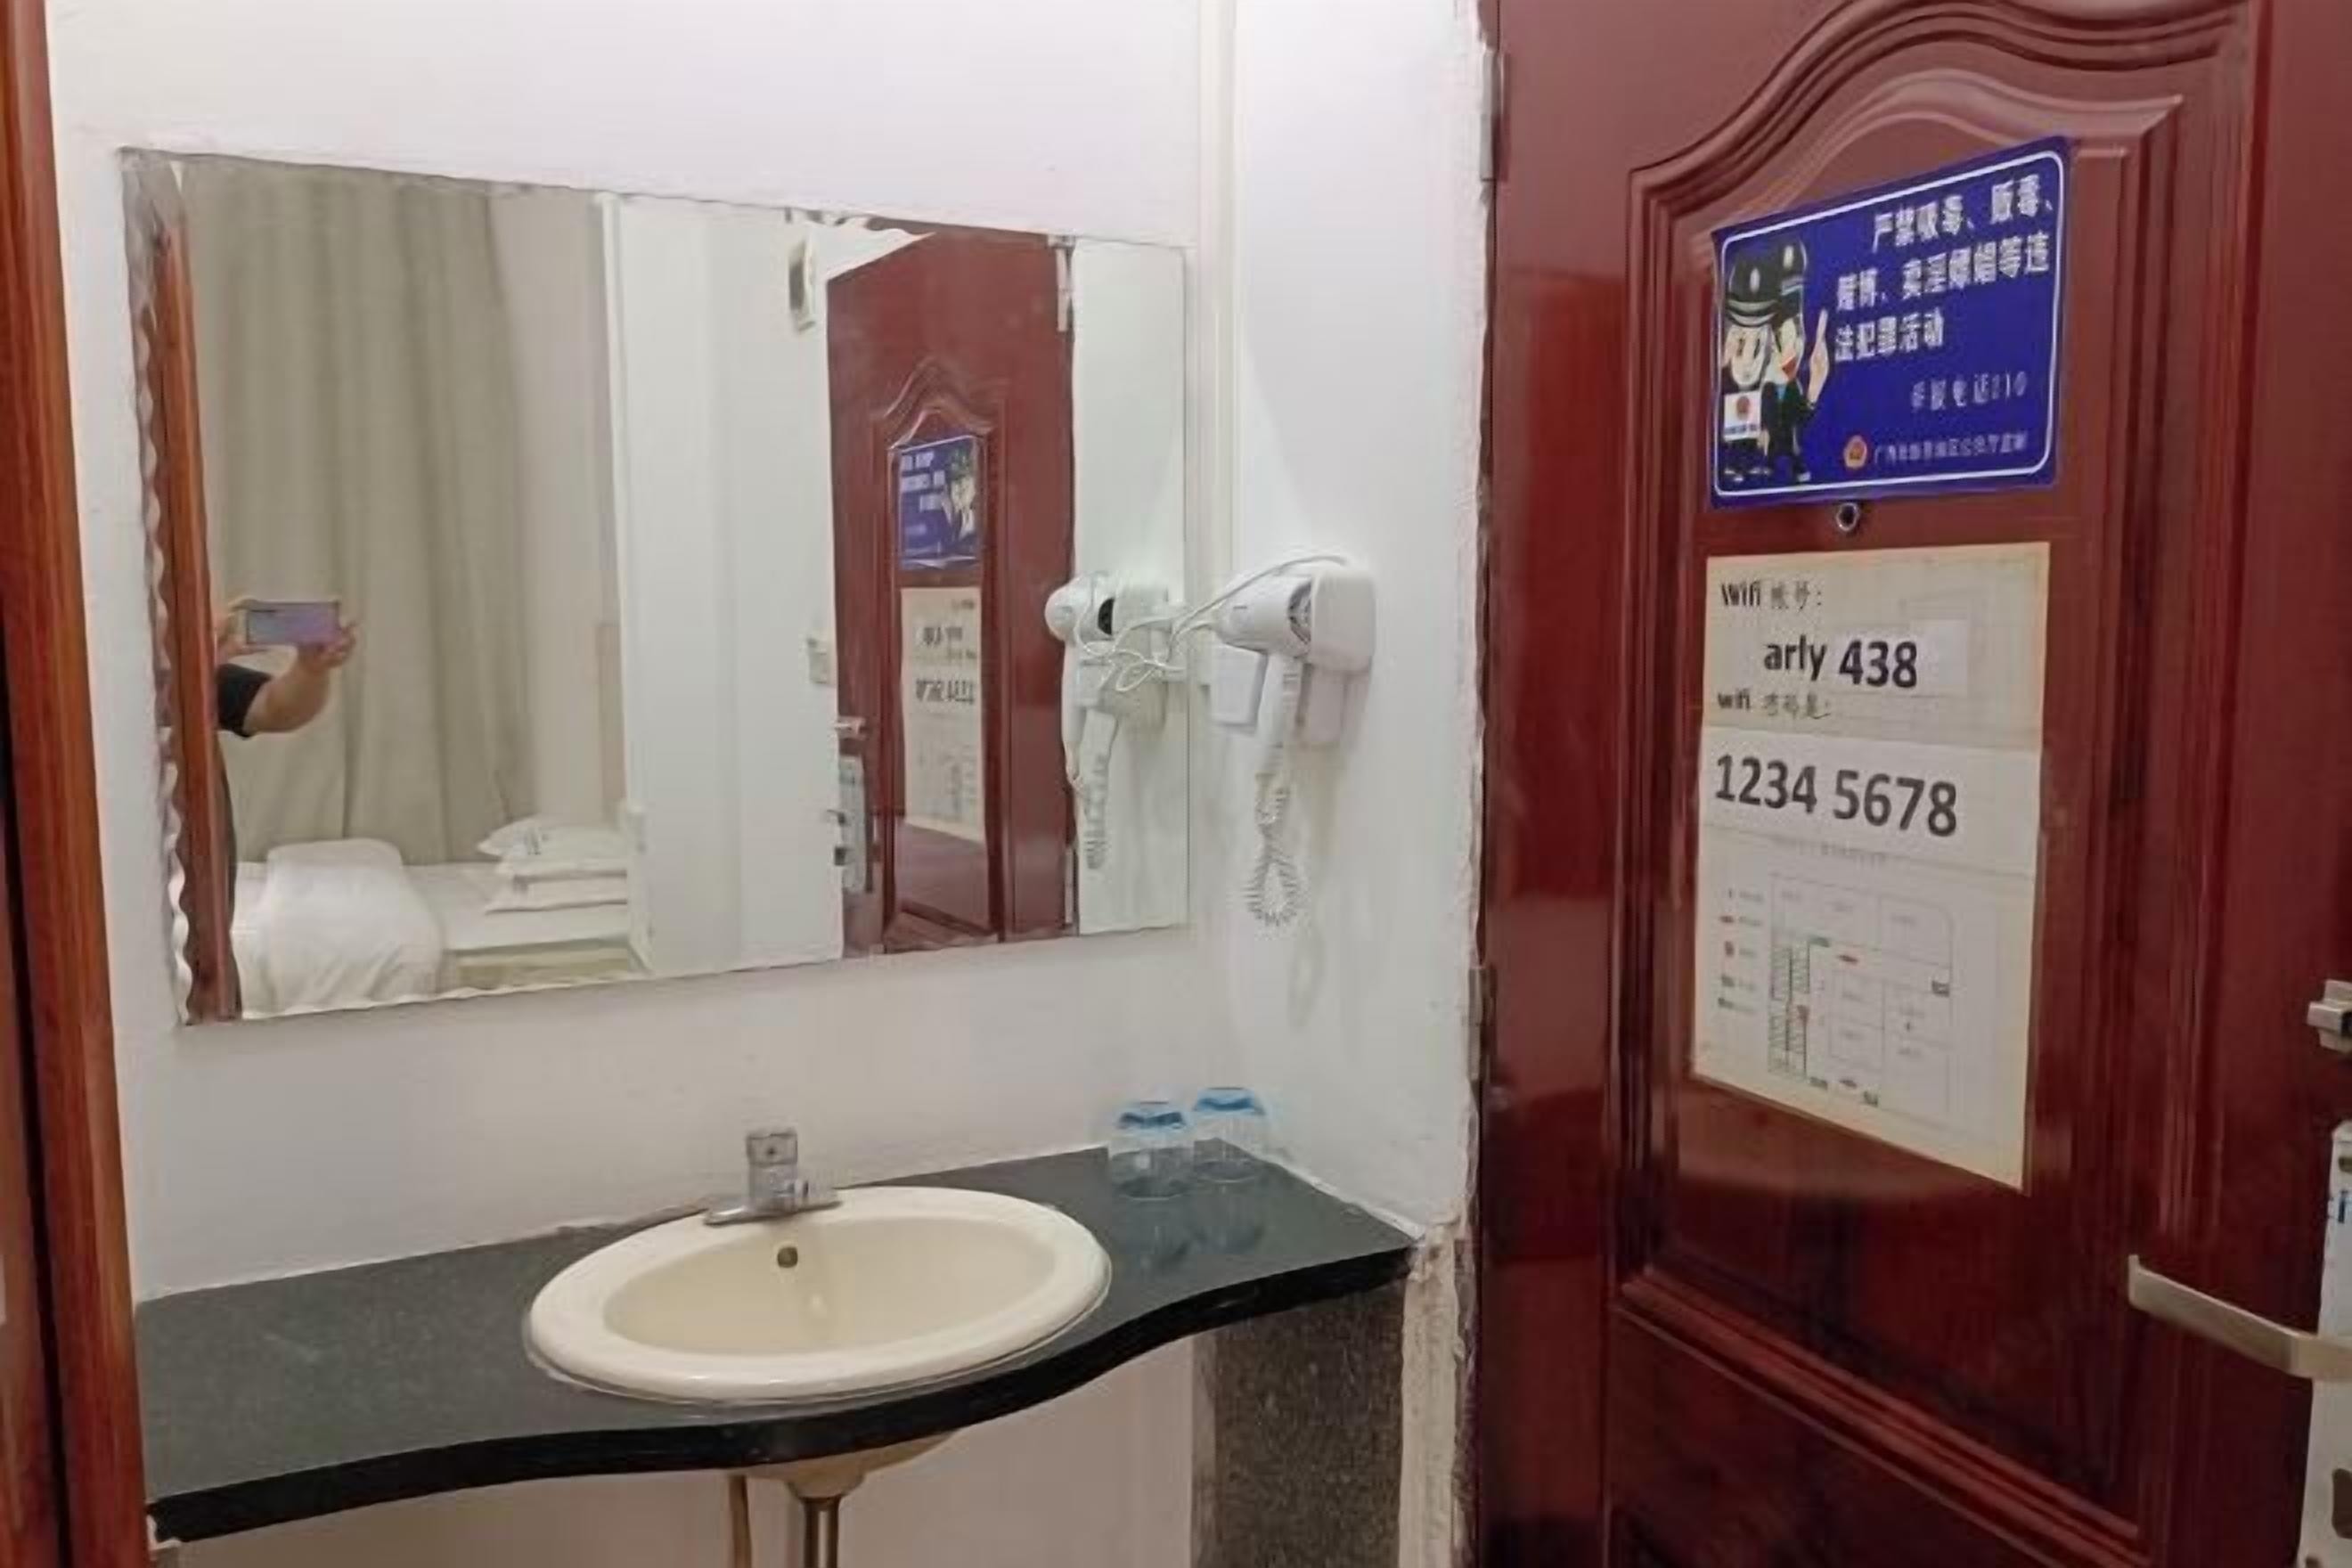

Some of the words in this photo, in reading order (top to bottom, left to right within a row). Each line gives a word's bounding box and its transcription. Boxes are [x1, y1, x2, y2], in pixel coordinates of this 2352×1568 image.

[1763, 634, 1827, 682] arly
[1838, 640, 1918, 689] 438
[1715, 754, 1818, 815] 1234
[1833, 769, 1957, 838] 5678
